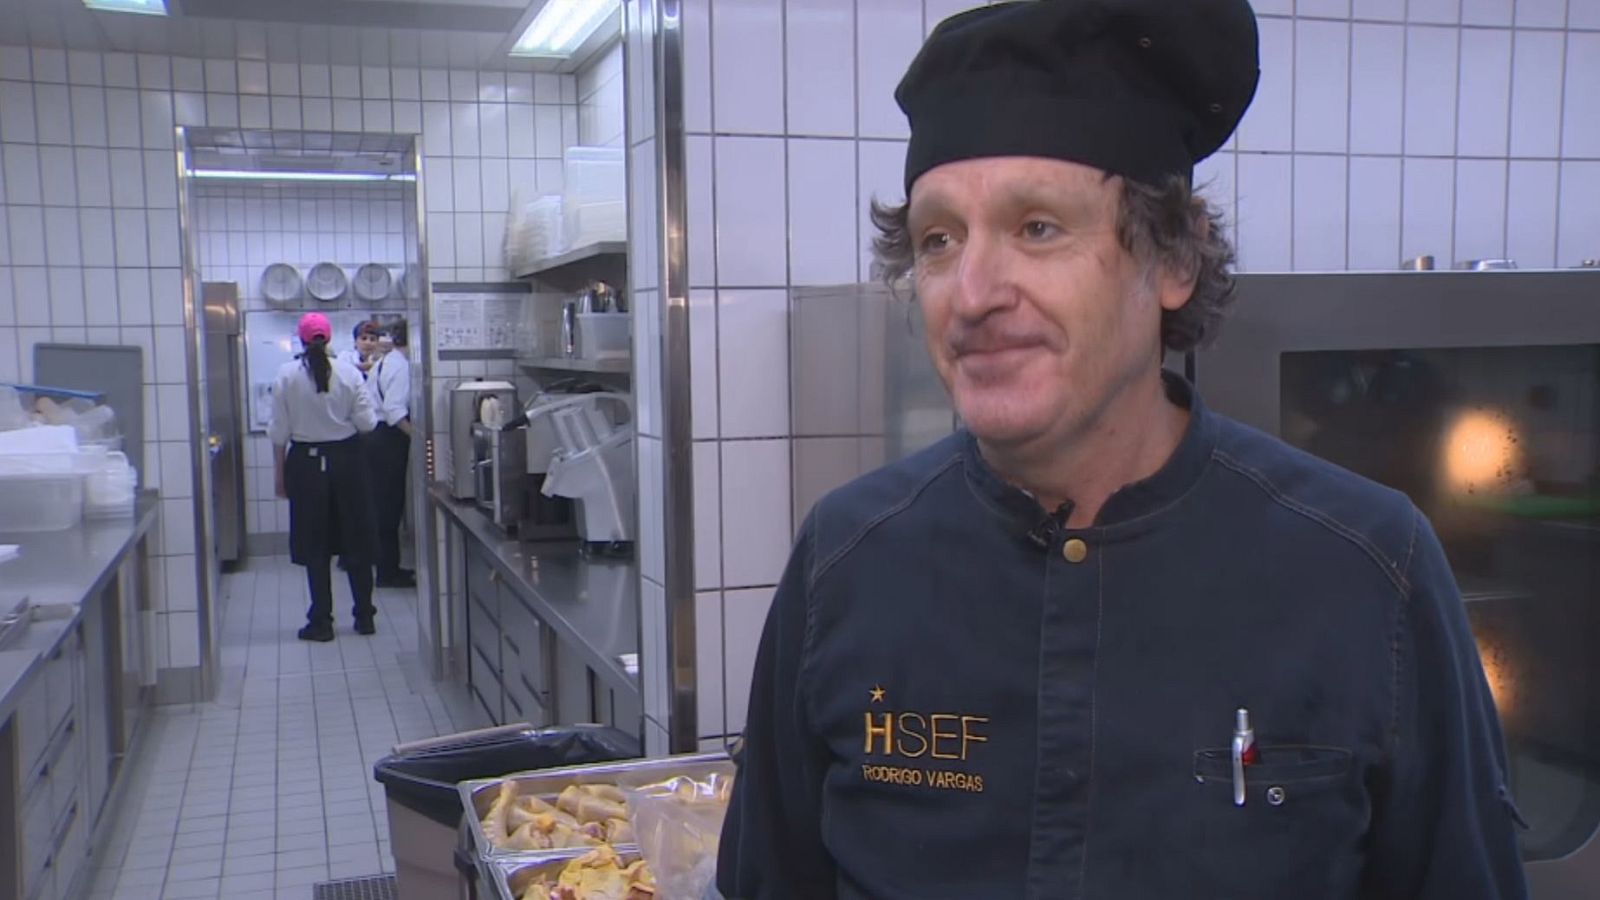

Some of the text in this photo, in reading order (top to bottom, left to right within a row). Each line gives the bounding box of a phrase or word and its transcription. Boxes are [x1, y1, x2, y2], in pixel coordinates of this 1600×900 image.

[864, 712, 989, 760] HSEF
[862, 765, 983, 792] RODRIGO VARGAS
